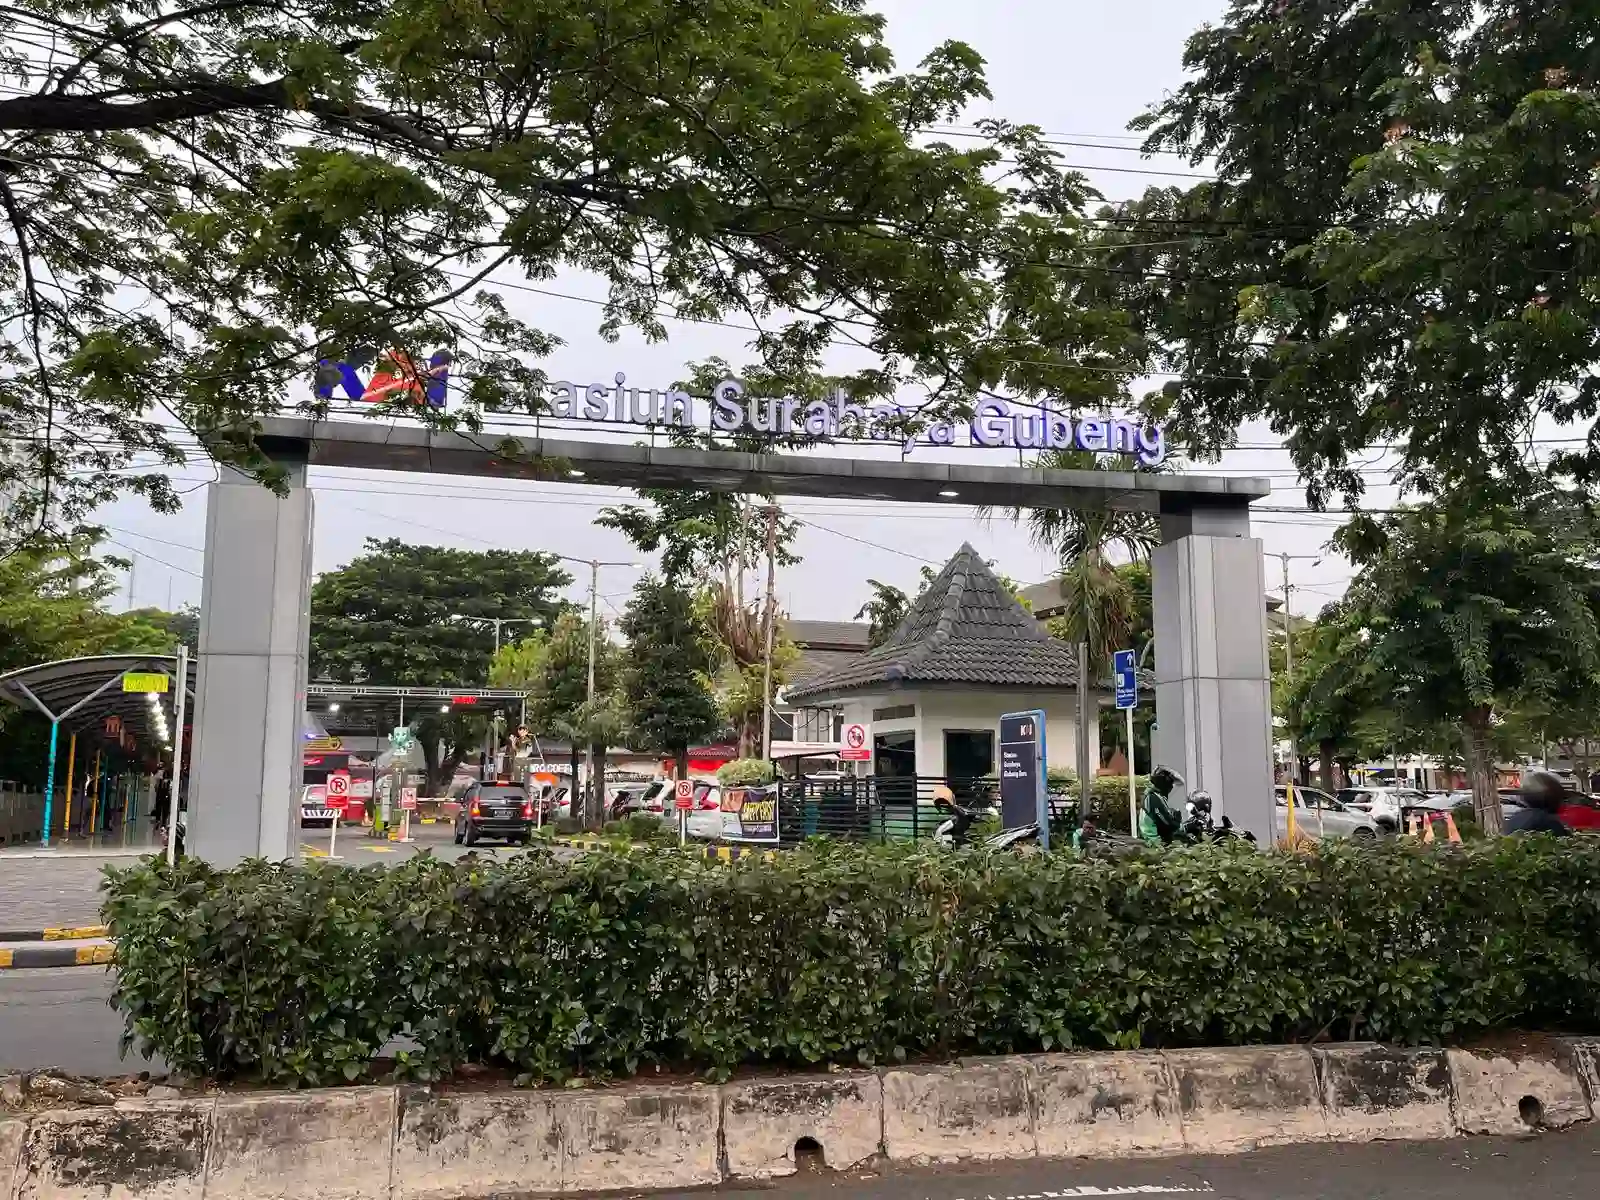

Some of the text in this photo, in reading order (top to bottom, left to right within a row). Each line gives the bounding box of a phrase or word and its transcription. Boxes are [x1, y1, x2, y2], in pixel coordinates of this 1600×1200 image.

[485, 371, 694, 428] asiun
[969, 397, 1167, 466] Gubeng
[1020, 724, 1033, 736] KI
